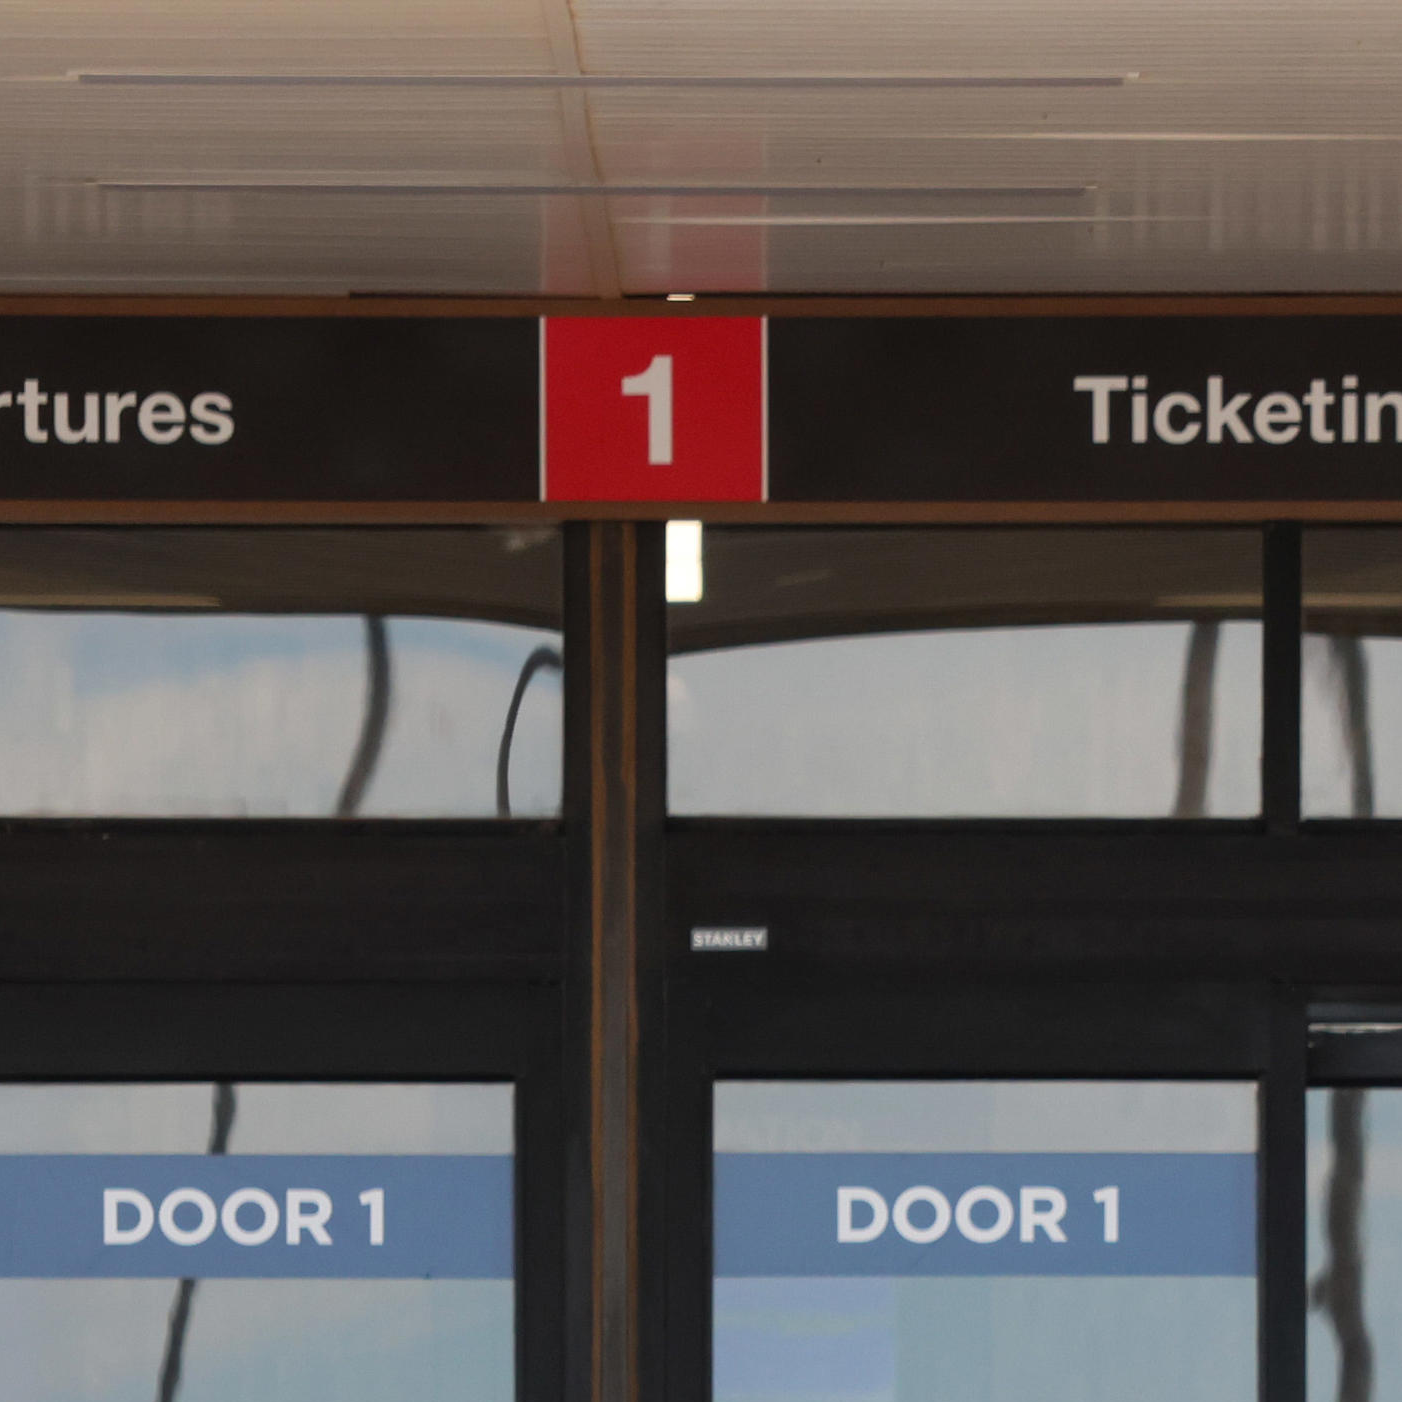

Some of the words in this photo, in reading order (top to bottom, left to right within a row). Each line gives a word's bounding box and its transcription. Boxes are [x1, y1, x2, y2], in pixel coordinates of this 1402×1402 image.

[621, 354, 674, 465] 1
[693, 931, 763, 948] STANLEY
[103, 1187, 333, 1246] DOOR
[358, 1187, 384, 1246] 1
[837, 1185, 1068, 1244] DOOR
[1093, 1185, 1119, 1244] 1
